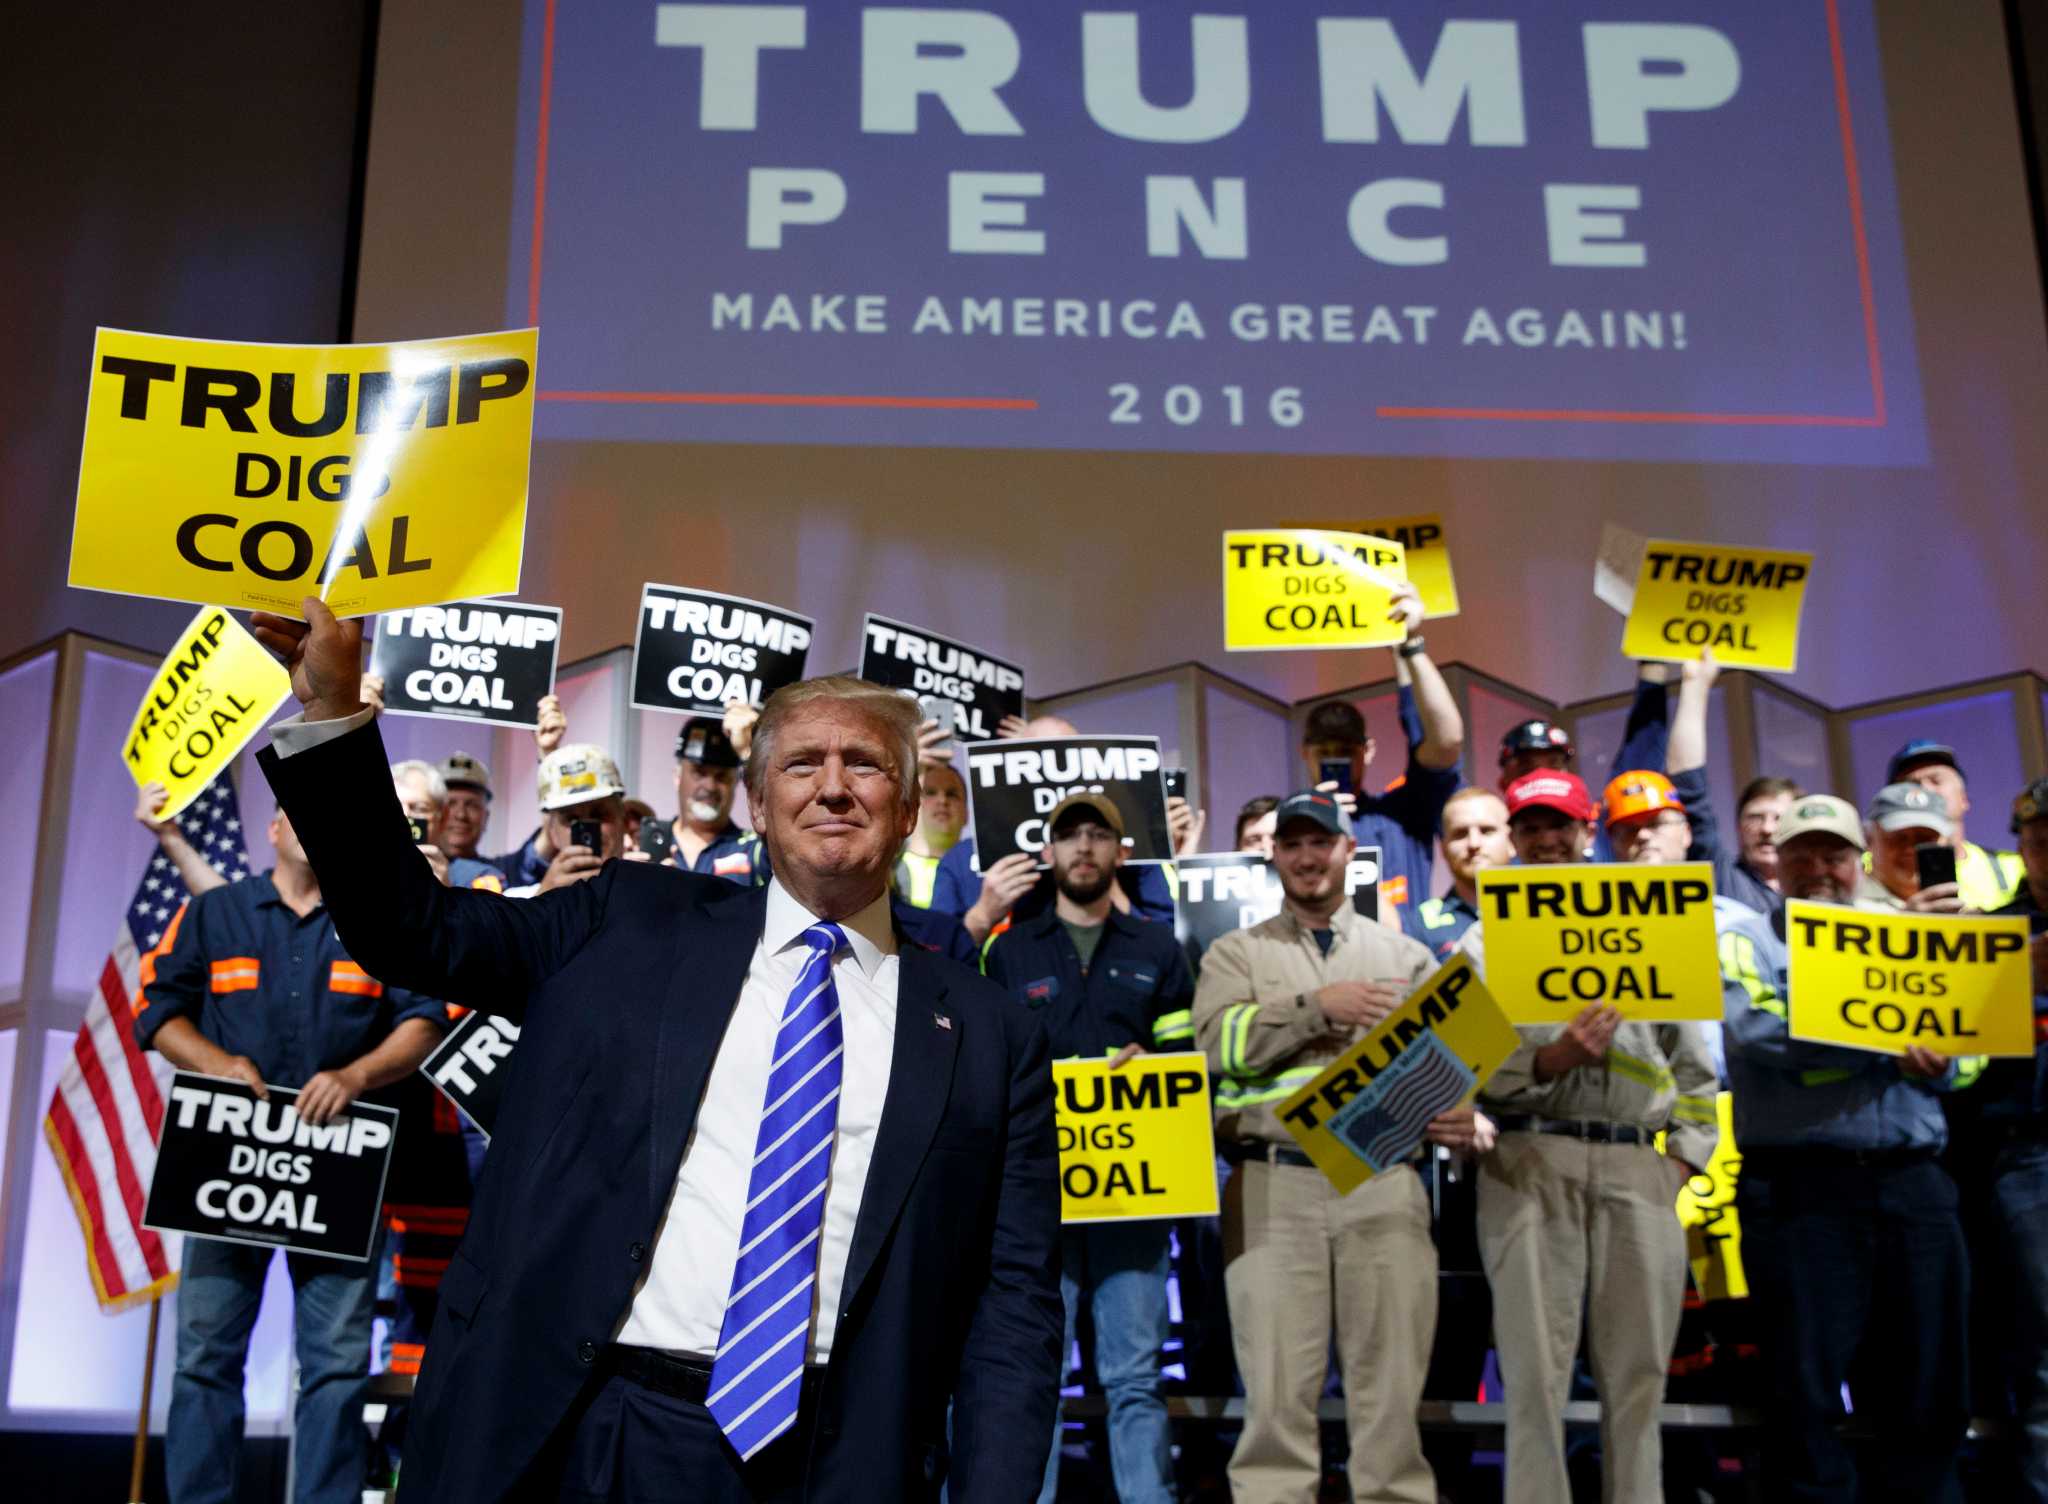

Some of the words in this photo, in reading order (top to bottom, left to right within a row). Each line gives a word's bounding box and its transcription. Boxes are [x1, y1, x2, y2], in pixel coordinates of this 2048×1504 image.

[655, 3, 1742, 149] TRUMP
[746, 167, 1648, 268] PENCE
[711, 292, 888, 333] MAKE
[912, 296, 1206, 341] AMERICA
[1230, 303, 1438, 345] GREAT
[1462, 308, 1690, 350] AGAIN!
[101, 354, 530, 438] TRUMP
[1109, 382, 1305, 428] 2016
[175, 513, 432, 586] COAL
[1230, 543, 1399, 569] TRUMP
[1284, 575, 1347, 596] DIGS
[1648, 552, 1806, 591] TRUMP
[1265, 603, 1368, 631] COAL
[1685, 590, 1748, 616] DIGS
[383, 606, 558, 649] TRUMP
[643, 595, 812, 656] TRUMP
[1662, 617, 1758, 652] COAL
[429, 642, 498, 673] DIGS
[690, 638, 758, 672] DIGS
[866, 622, 1023, 692] TRUMP
[128, 613, 226, 764] TRUMP
[405, 669, 514, 711] COAL
[667, 665, 766, 710] COAL
[912, 666, 976, 703] DIGS
[163, 681, 213, 741] DIGS
[168, 693, 256, 779] COAL
[968, 747, 1161, 788] TRUMP
[1178, 859, 1379, 902] TRUP
[1483, 879, 1710, 920] TRUMP
[1560, 927, 1643, 955] DIGS
[1793, 916, 2025, 964] TRUMP
[1537, 965, 1674, 1002] COAL
[1864, 966, 1948, 998] DIGS
[1840, 998, 1980, 1038] COAL
[1282, 964, 1472, 1130] TRUMP
[171, 1085, 392, 1158] TRUMP
[1056, 1122, 1136, 1153] DIGS
[228, 1143, 314, 1185] DIGS
[1062, 1160, 1168, 1199] OAL
[195, 1178, 328, 1235] COAL
